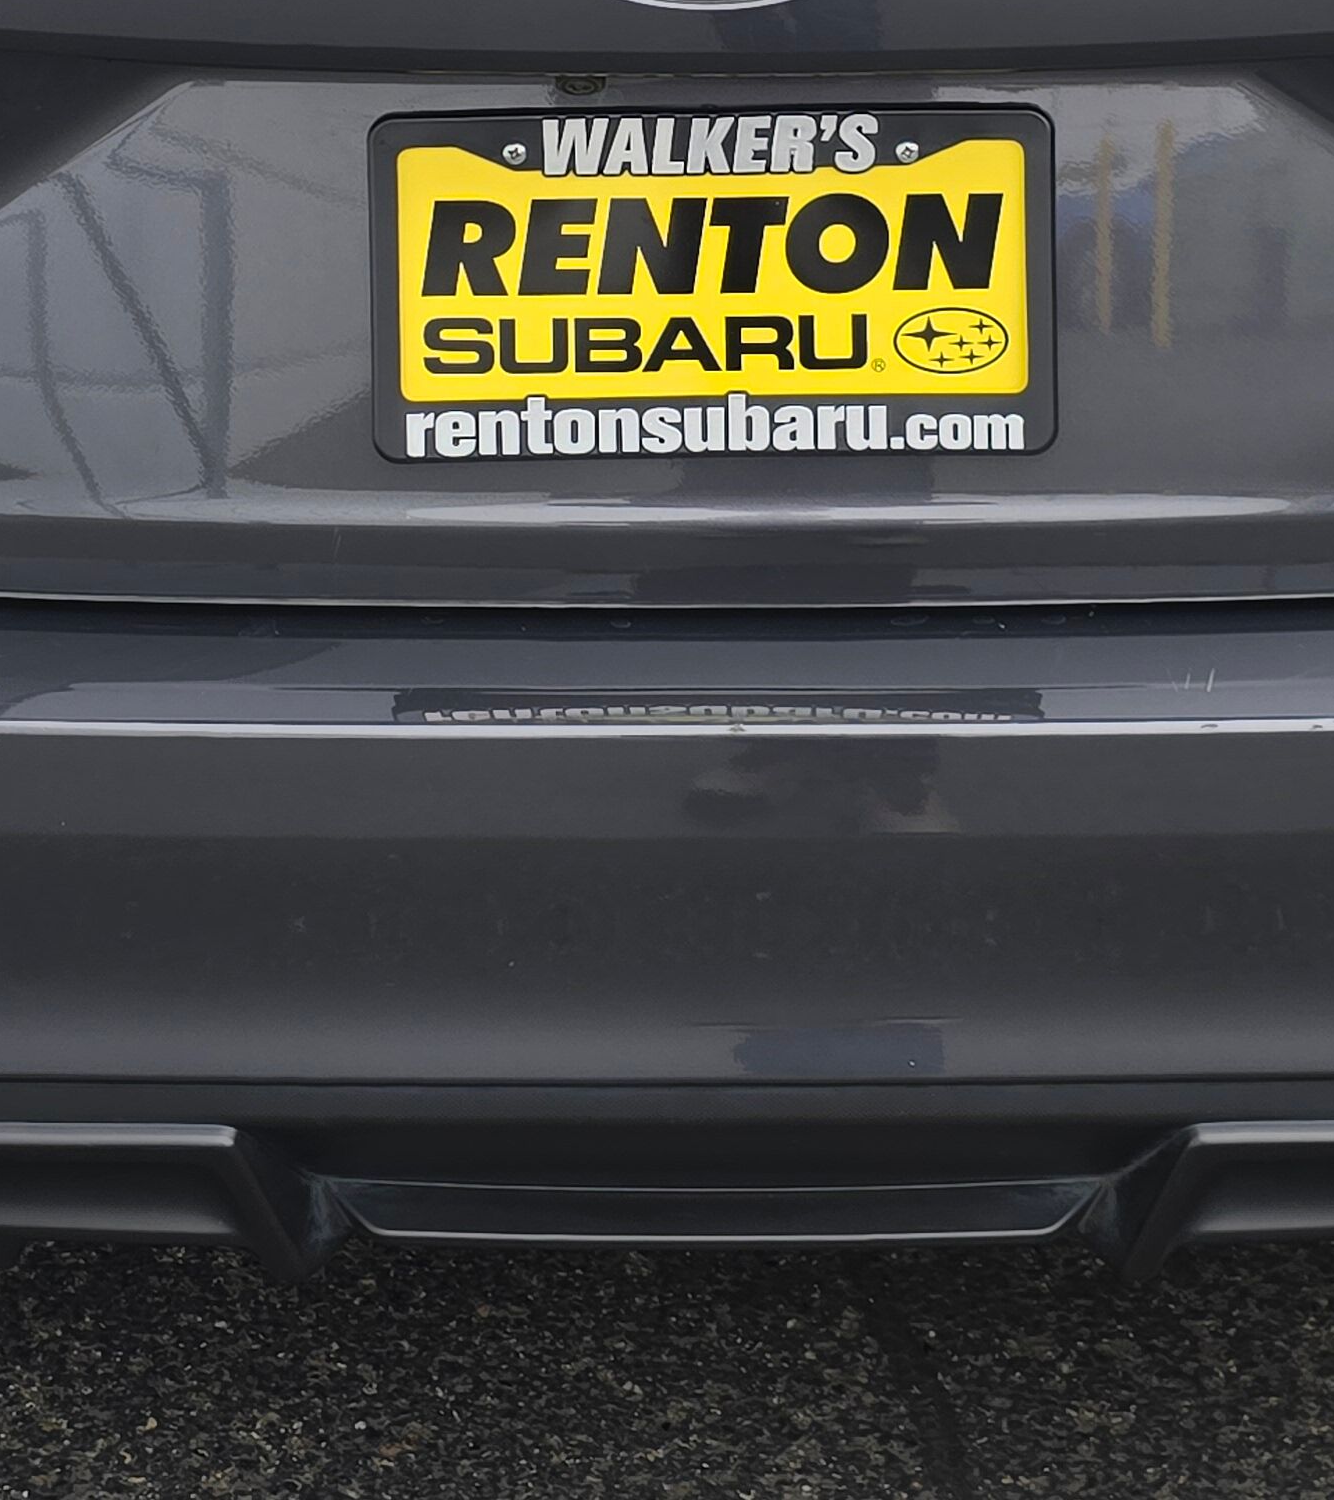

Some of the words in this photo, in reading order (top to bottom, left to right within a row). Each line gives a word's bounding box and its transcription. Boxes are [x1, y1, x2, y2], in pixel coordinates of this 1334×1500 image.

[542, 114, 878, 177] WALKER'S
[421, 193, 1003, 297] RENTON
[406, 395, 1023, 457] rentonsubaru.com
